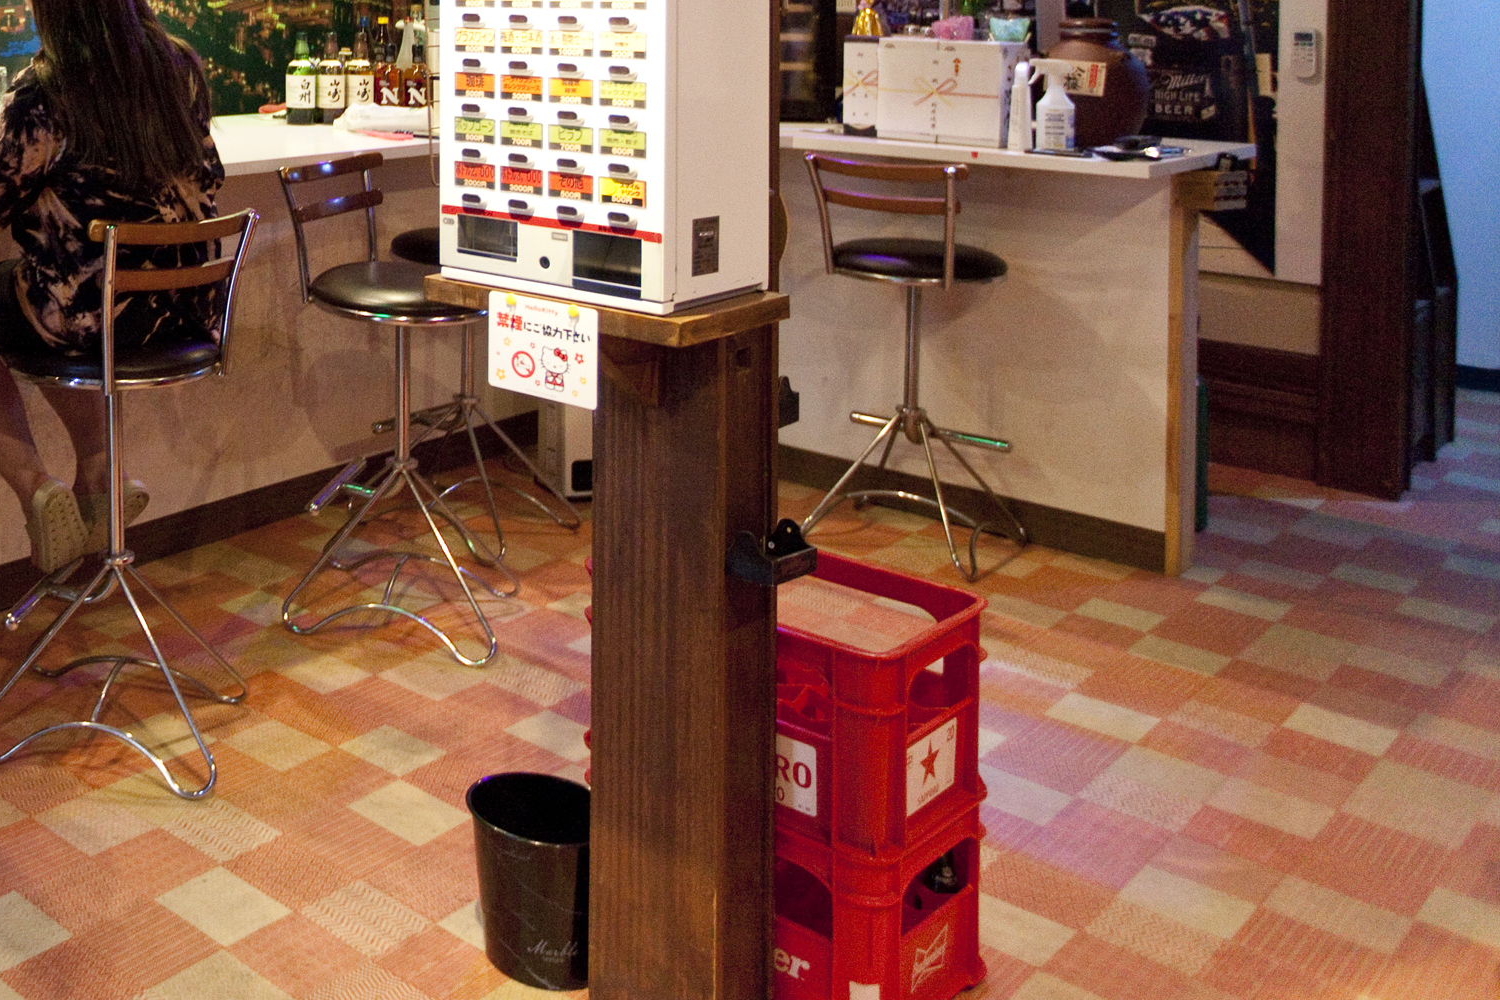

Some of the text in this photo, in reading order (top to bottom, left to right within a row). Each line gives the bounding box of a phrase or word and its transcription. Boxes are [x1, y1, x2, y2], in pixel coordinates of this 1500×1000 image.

[299, 79, 311, 104] 白州
[380, 87, 399, 105] N
[408, 87, 427, 105] N
[497, 311, 591, 344] 禁煙にご協力下さい
